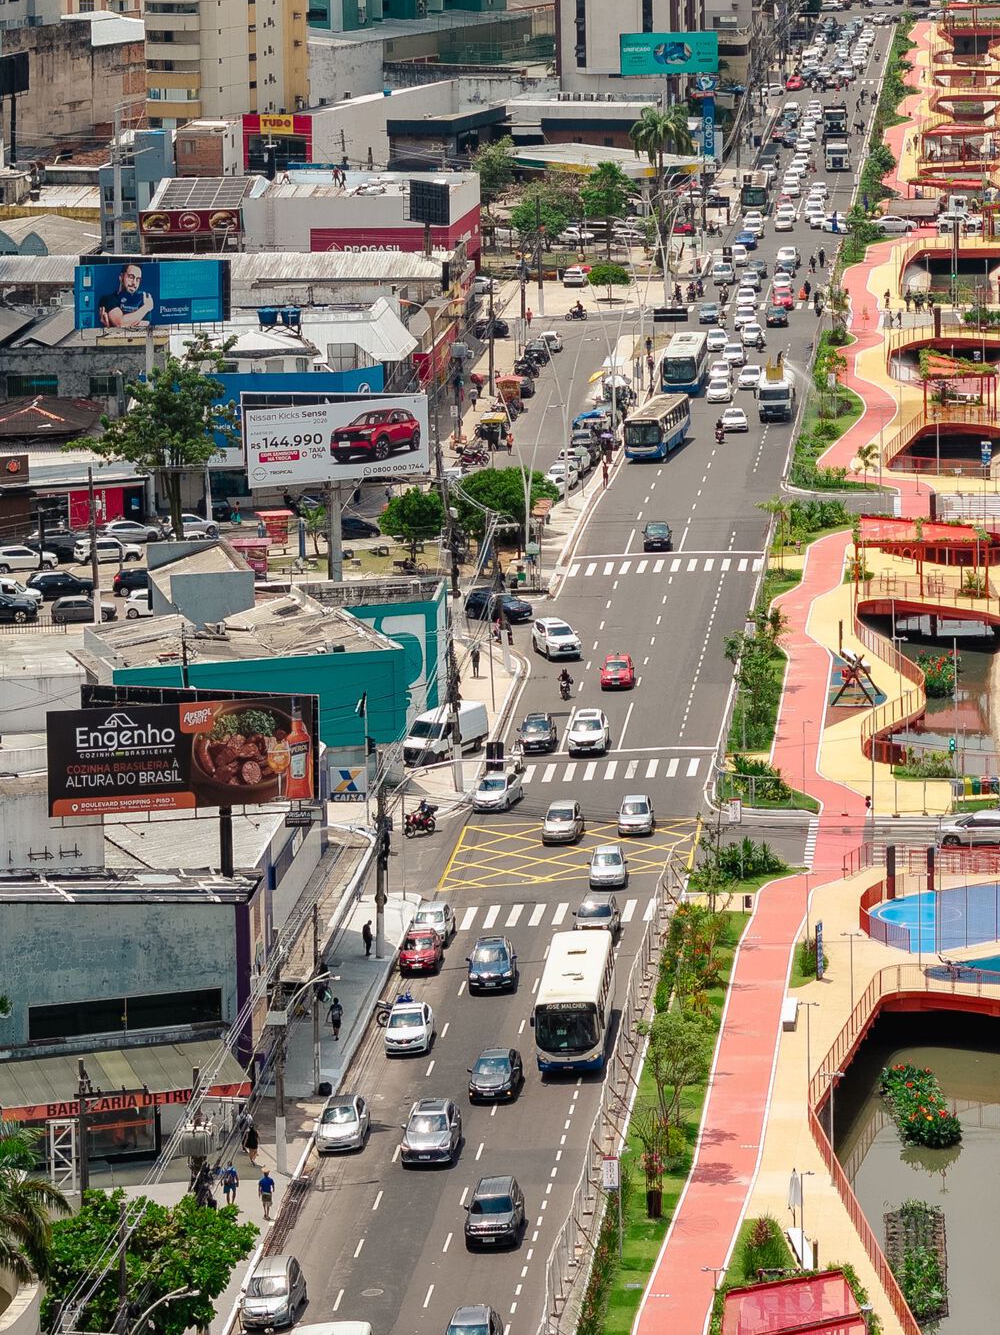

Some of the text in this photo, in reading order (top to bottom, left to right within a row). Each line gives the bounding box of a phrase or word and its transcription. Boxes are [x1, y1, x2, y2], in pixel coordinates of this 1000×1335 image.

[262, 118, 291, 127] TUDO
[705, 116, 713, 148] GLOBO
[344, 244, 400, 252] DROGASIL
[249, 413, 277, 422] Nissan
[278, 411, 300, 419] Kicks
[301, 410, 327, 418] Sense
[262, 433, 323, 449] 144.990
[309, 446, 327, 454] TAXA
[183, 708, 212, 723] APEROL
[76, 724, 176, 752] Engenho
[125, 748, 173, 756] BRASILEIRA
[66, 758, 180, 775] COZINHA BRASILEIRA À
[65, 770, 182, 789] ALTURA DO BRASIL
[81, 800, 119, 809] BOULEVARD
[120, 798, 151, 806] SHOPPING
[333, 794, 364, 802] CAIXA
